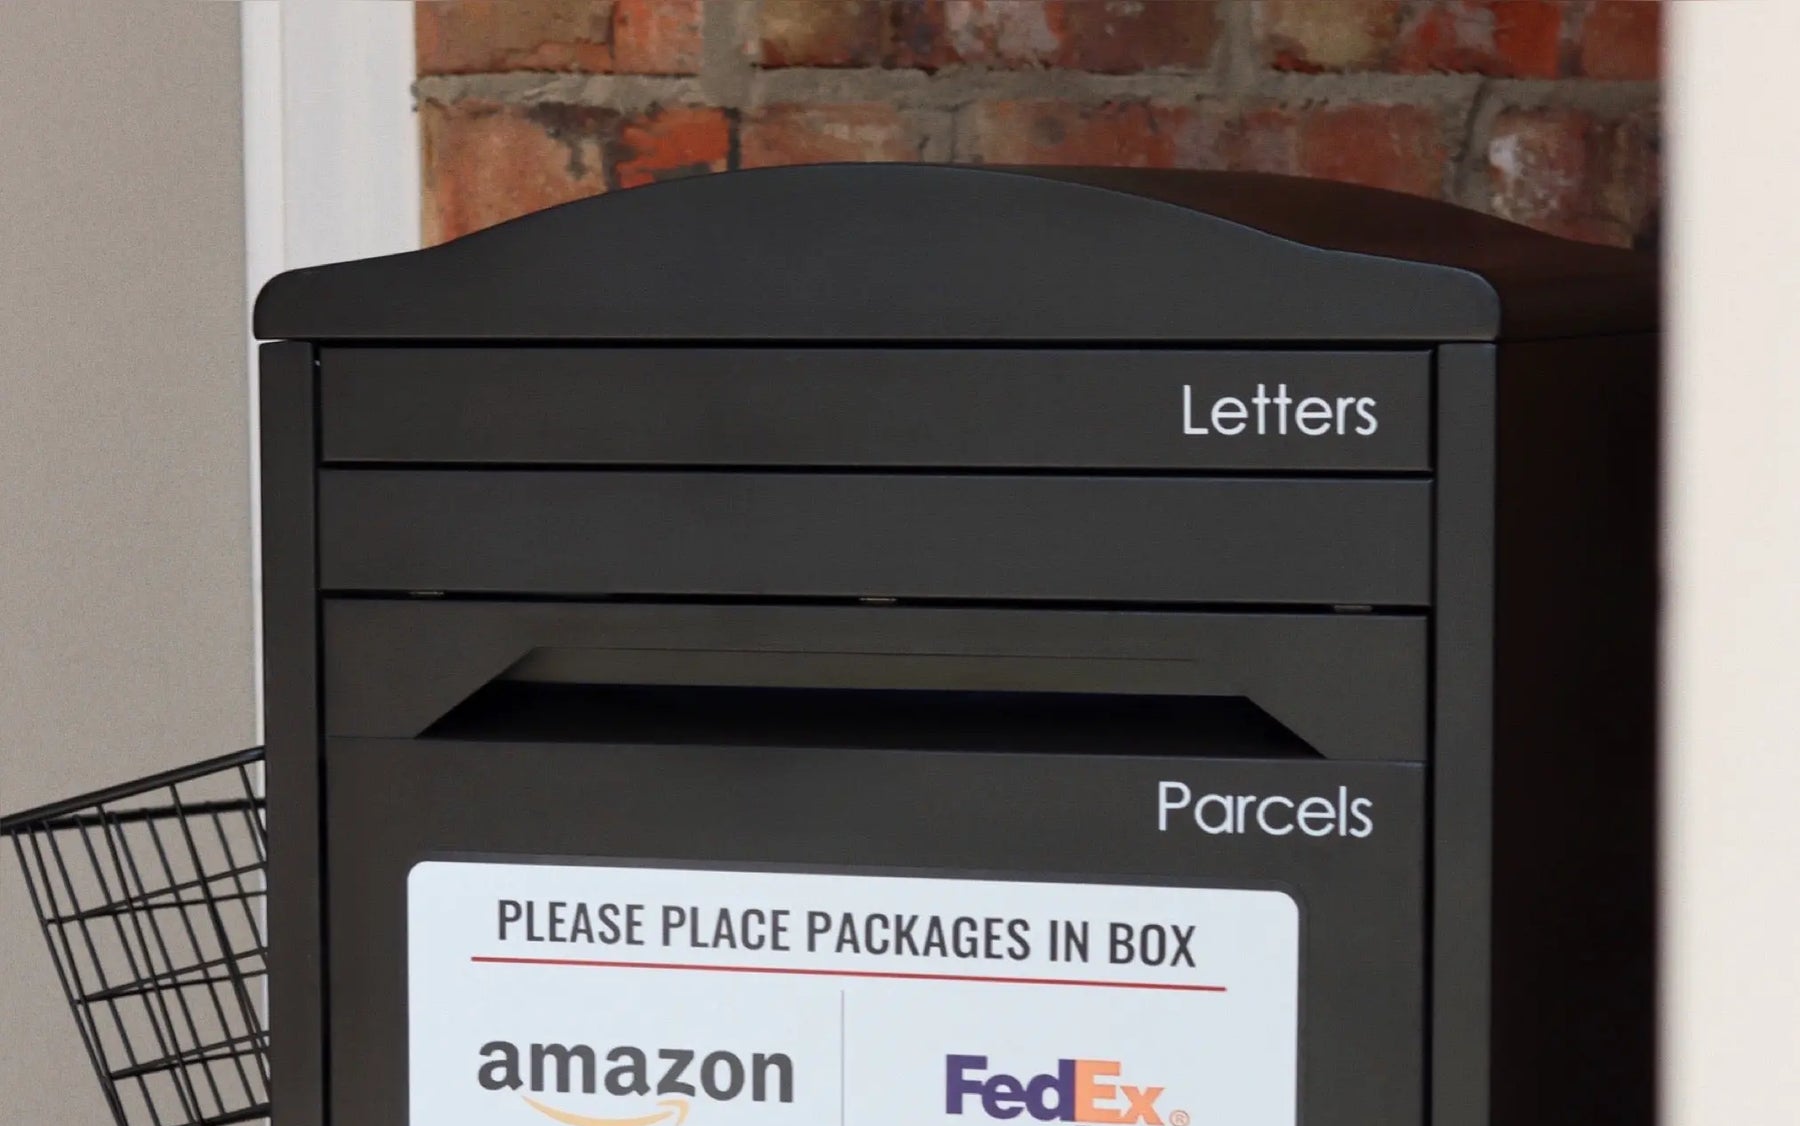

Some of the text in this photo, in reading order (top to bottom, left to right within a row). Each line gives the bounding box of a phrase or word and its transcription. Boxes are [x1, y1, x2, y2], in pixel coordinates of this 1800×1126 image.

[1183, 383, 1379, 437] Letters
[1158, 780, 1375, 839] Parcels
[497, 898, 1198, 968] PLEASE PLACE PACKAGES IN BOX
[477, 1037, 795, 1104] amazon
